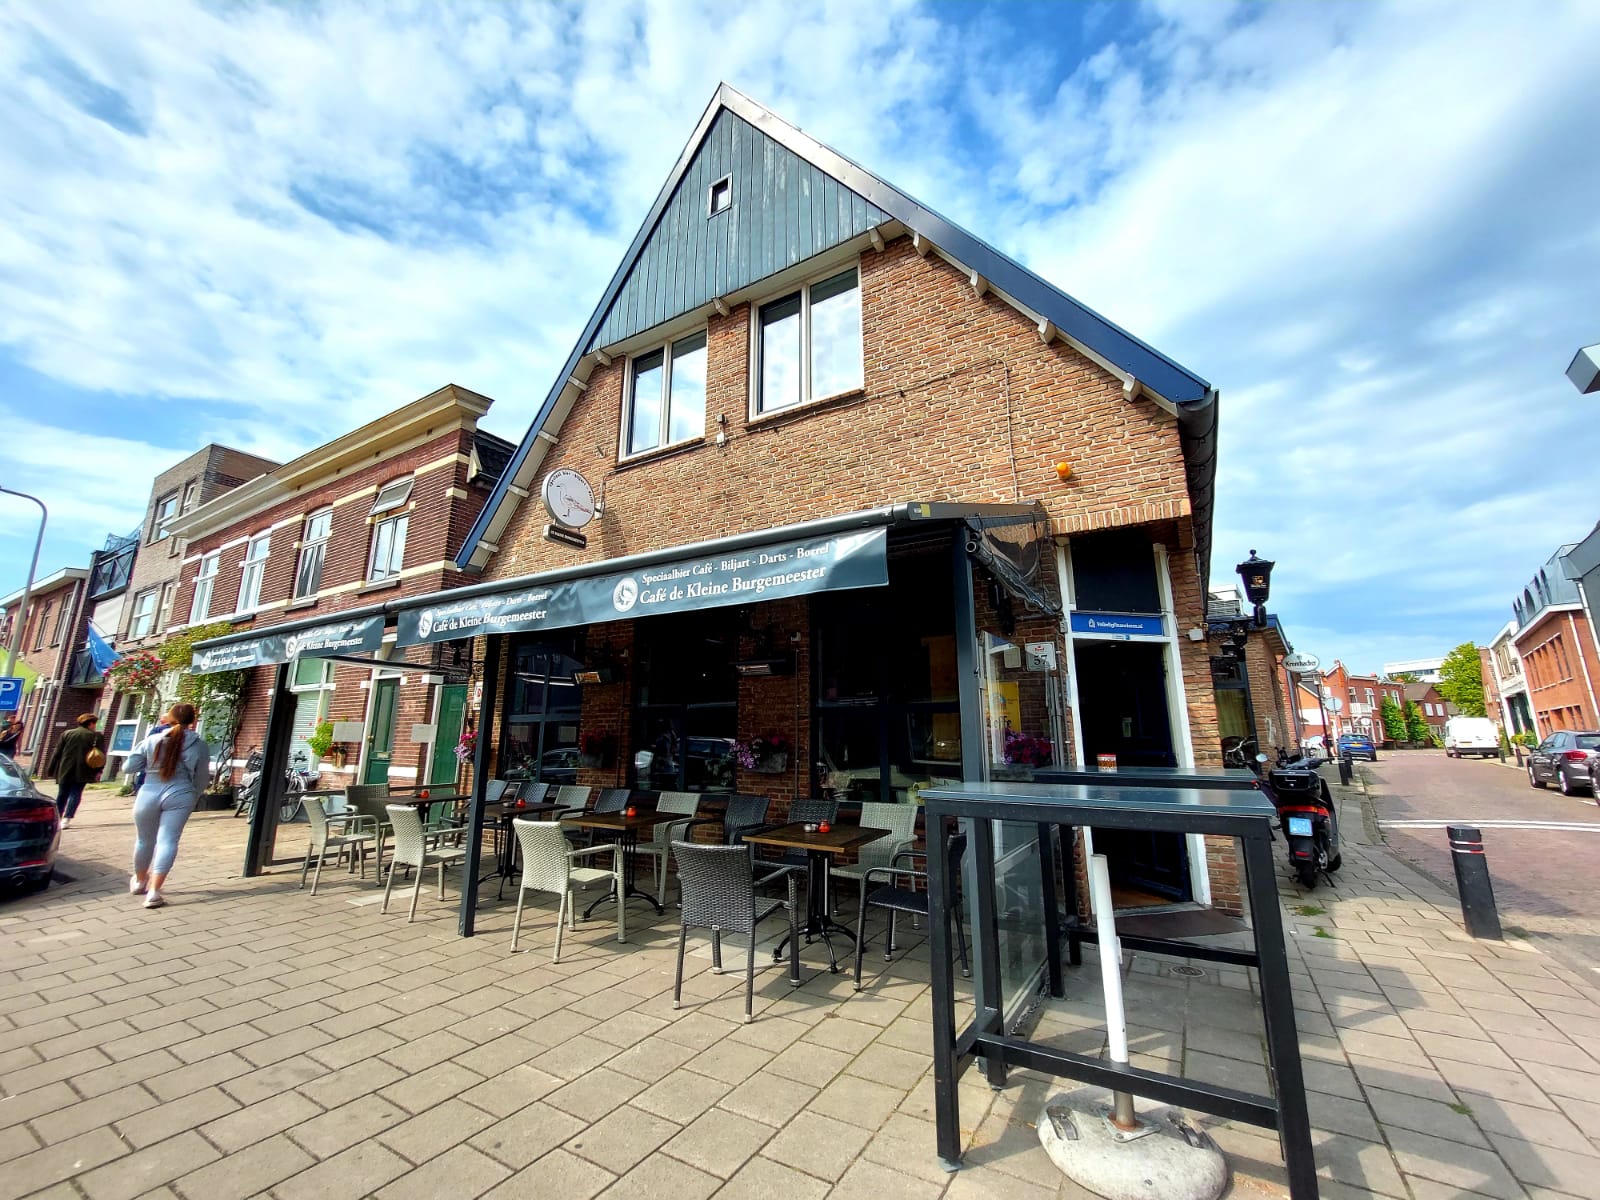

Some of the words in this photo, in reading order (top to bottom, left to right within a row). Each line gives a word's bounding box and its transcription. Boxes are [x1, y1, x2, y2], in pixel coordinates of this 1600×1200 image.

[642, 568, 690, 585] Speciaalbier
[692, 562, 713, 576] Café
[721, 558, 750, 572] Biljart
[758, 551, 787, 565] Darts
[796, 544, 830, 559] Borrel
[640, 588, 667, 604] Café
[669, 586, 684, 600] de
[686, 580, 728, 598] Kleine
[732, 566, 827, 594] Burgemeester
[432, 619, 449, 633] Café
[449, 618, 459, 630] de
[459, 615, 482, 628] Kleine
[483, 609, 548, 627] Burgemeester
[323, 636, 364, 651] Burgemeester
[1033, 654, 1048, 666] 57
